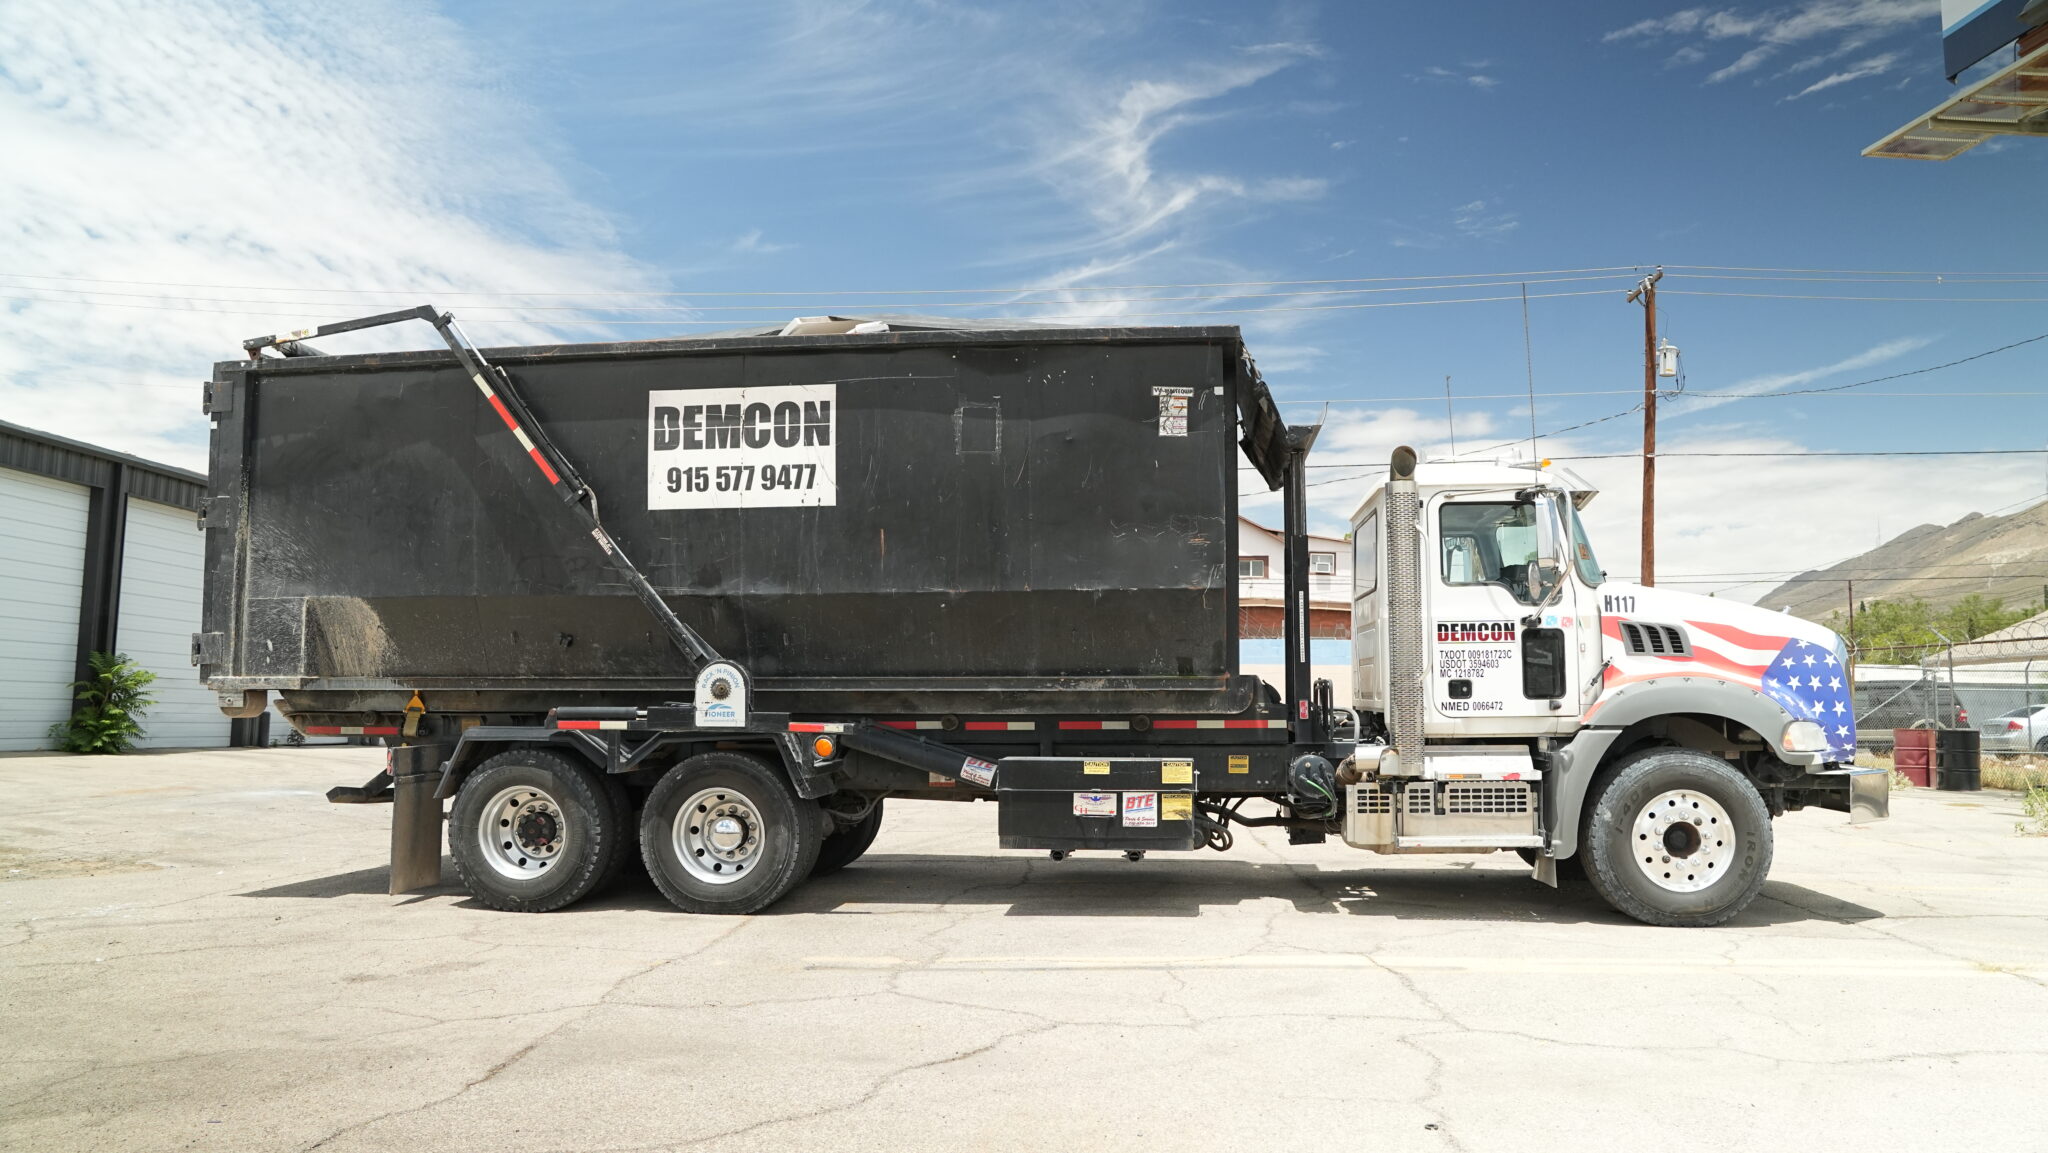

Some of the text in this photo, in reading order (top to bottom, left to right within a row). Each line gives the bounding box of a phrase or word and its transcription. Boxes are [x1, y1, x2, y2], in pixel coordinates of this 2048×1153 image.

[654, 400, 830, 451] DEMCON
[667, 464, 816, 493] 915 577 9477
[1604, 594, 1635, 613] H117
[1437, 622, 1515, 641] DEMCON
[1439, 649, 1512, 659] TXDOT 009181723C
[1440, 659, 1499, 668] USDOT 3594603
[1440, 668, 1485, 678] MC 1218782
[1441, 701, 1503, 711] NMED 0066472
[1125, 793, 1155, 809] BTE
